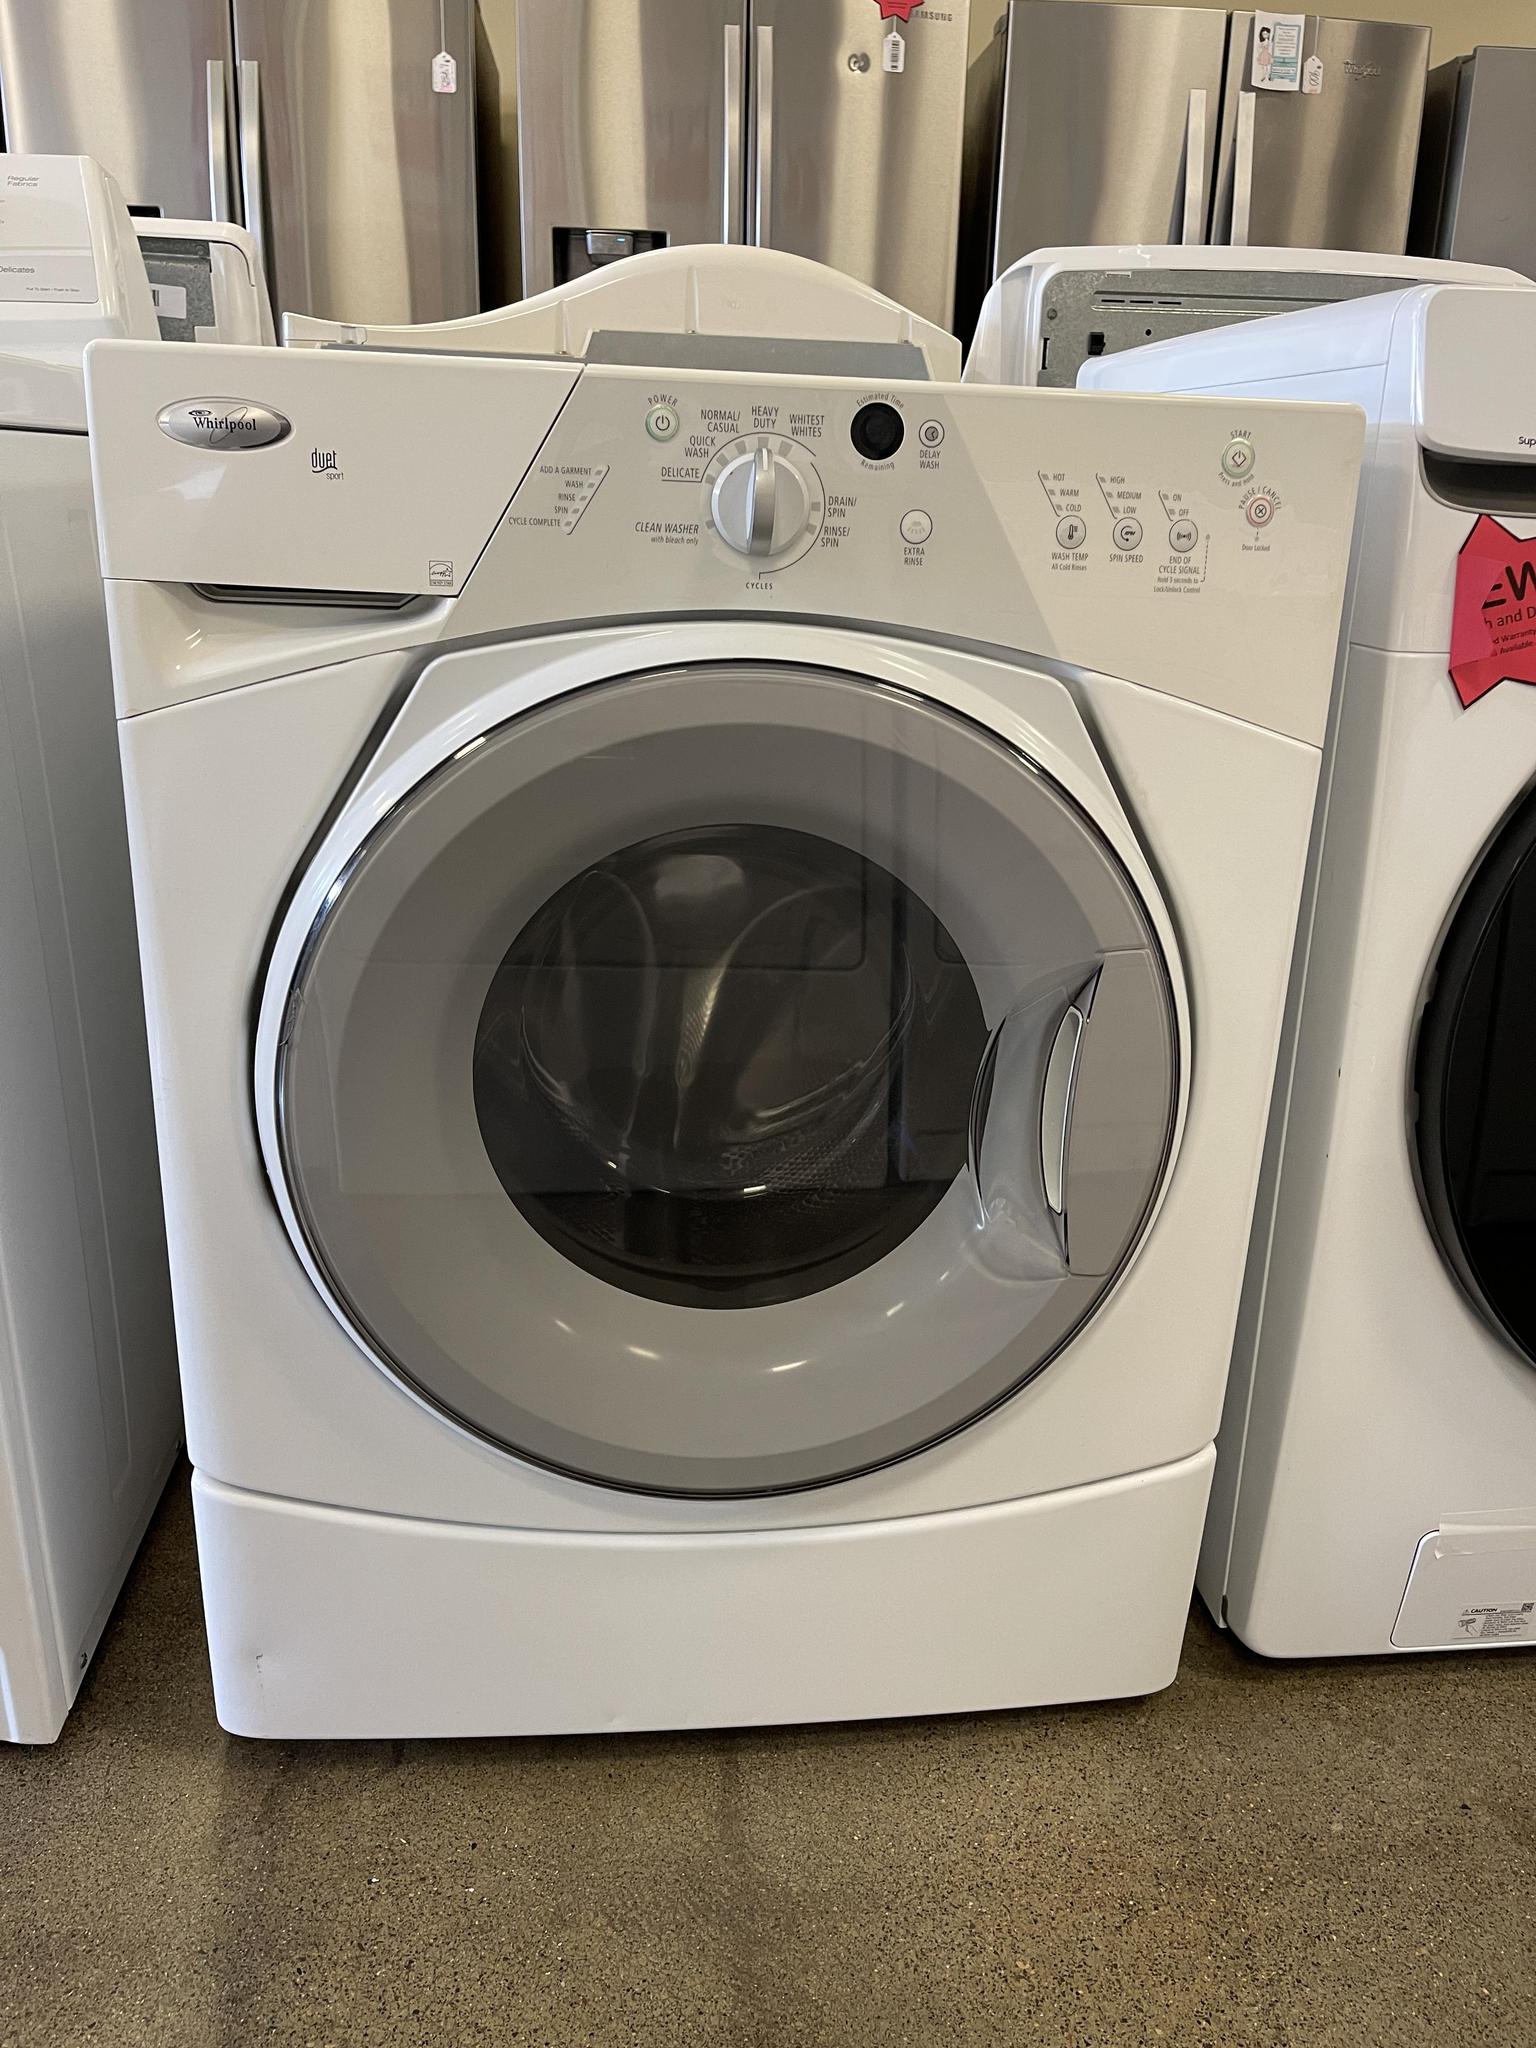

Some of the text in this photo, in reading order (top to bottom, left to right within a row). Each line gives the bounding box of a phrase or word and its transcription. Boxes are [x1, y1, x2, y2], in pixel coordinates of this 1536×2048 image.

[911, 10, 953, 21] AMSUNG
[648, 394, 678, 407] POWER
[856, 392, 904, 409] Estimated Time
[700, 409, 741, 422] NORMAL/
[751, 406, 779, 418] HEAVY
[193, 416, 257, 433] Whirlpool
[753, 418, 777, 429] DUTY
[789, 413, 825, 426] WHITEST
[707, 421, 739, 433] CASUAL
[791, 426, 822, 437] WHITES
[1230, 429, 1252, 439] START
[689, 435, 716, 447] QUICK
[685, 447, 709, 458] WASH
[919, 449, 941, 459] DELAY
[311, 447, 338, 473] duet
[860, 458, 895, 471] Remaining
[919, 461, 940, 470] WASH
[326, 471, 344, 481] sport
[540, 466, 592, 476] ADD A GARMENT
[661, 466, 700, 479] DELICATE
[1053, 473, 1065, 481] HOT
[1110, 476, 1125, 484] HIGH
[565, 480, 584, 489] WASH
[558, 493, 576, 502] RINSE
[1060, 489, 1079, 497] WARM
[1117, 491, 1142, 500] MEDIUM
[1172, 493, 1182, 502] ON
[828, 495, 857, 507] DRAIN/
[554, 506, 569, 514] SPIN
[828, 508, 846, 518] SPIN
[1065, 504, 1082, 512] COLD
[1123, 506, 1137, 514] LOW
[1178, 508, 1190, 516] OFF
[508, 516, 561, 527] CYCLE COMPLETE
[635, 522, 699, 534] CLEAN WASHER
[824, 526, 850, 537] RINSE/
[665, 536, 685, 545] bleach
[686, 537, 699, 546] only
[821, 537, 839, 548] SPIN
[904, 547, 925, 556] EXTRA
[1051, 552, 1088, 561] WASH TEMP
[904, 557, 923, 566] RINSE
[1109, 554, 1144, 563] SPIN SPEED
[1169, 556, 1191, 564] END OF
[1158, 565, 1200, 575] CYCLE SIGNAL
[746, 582, 773, 590] CYCLES
[1497, 608, 1522, 627] and
